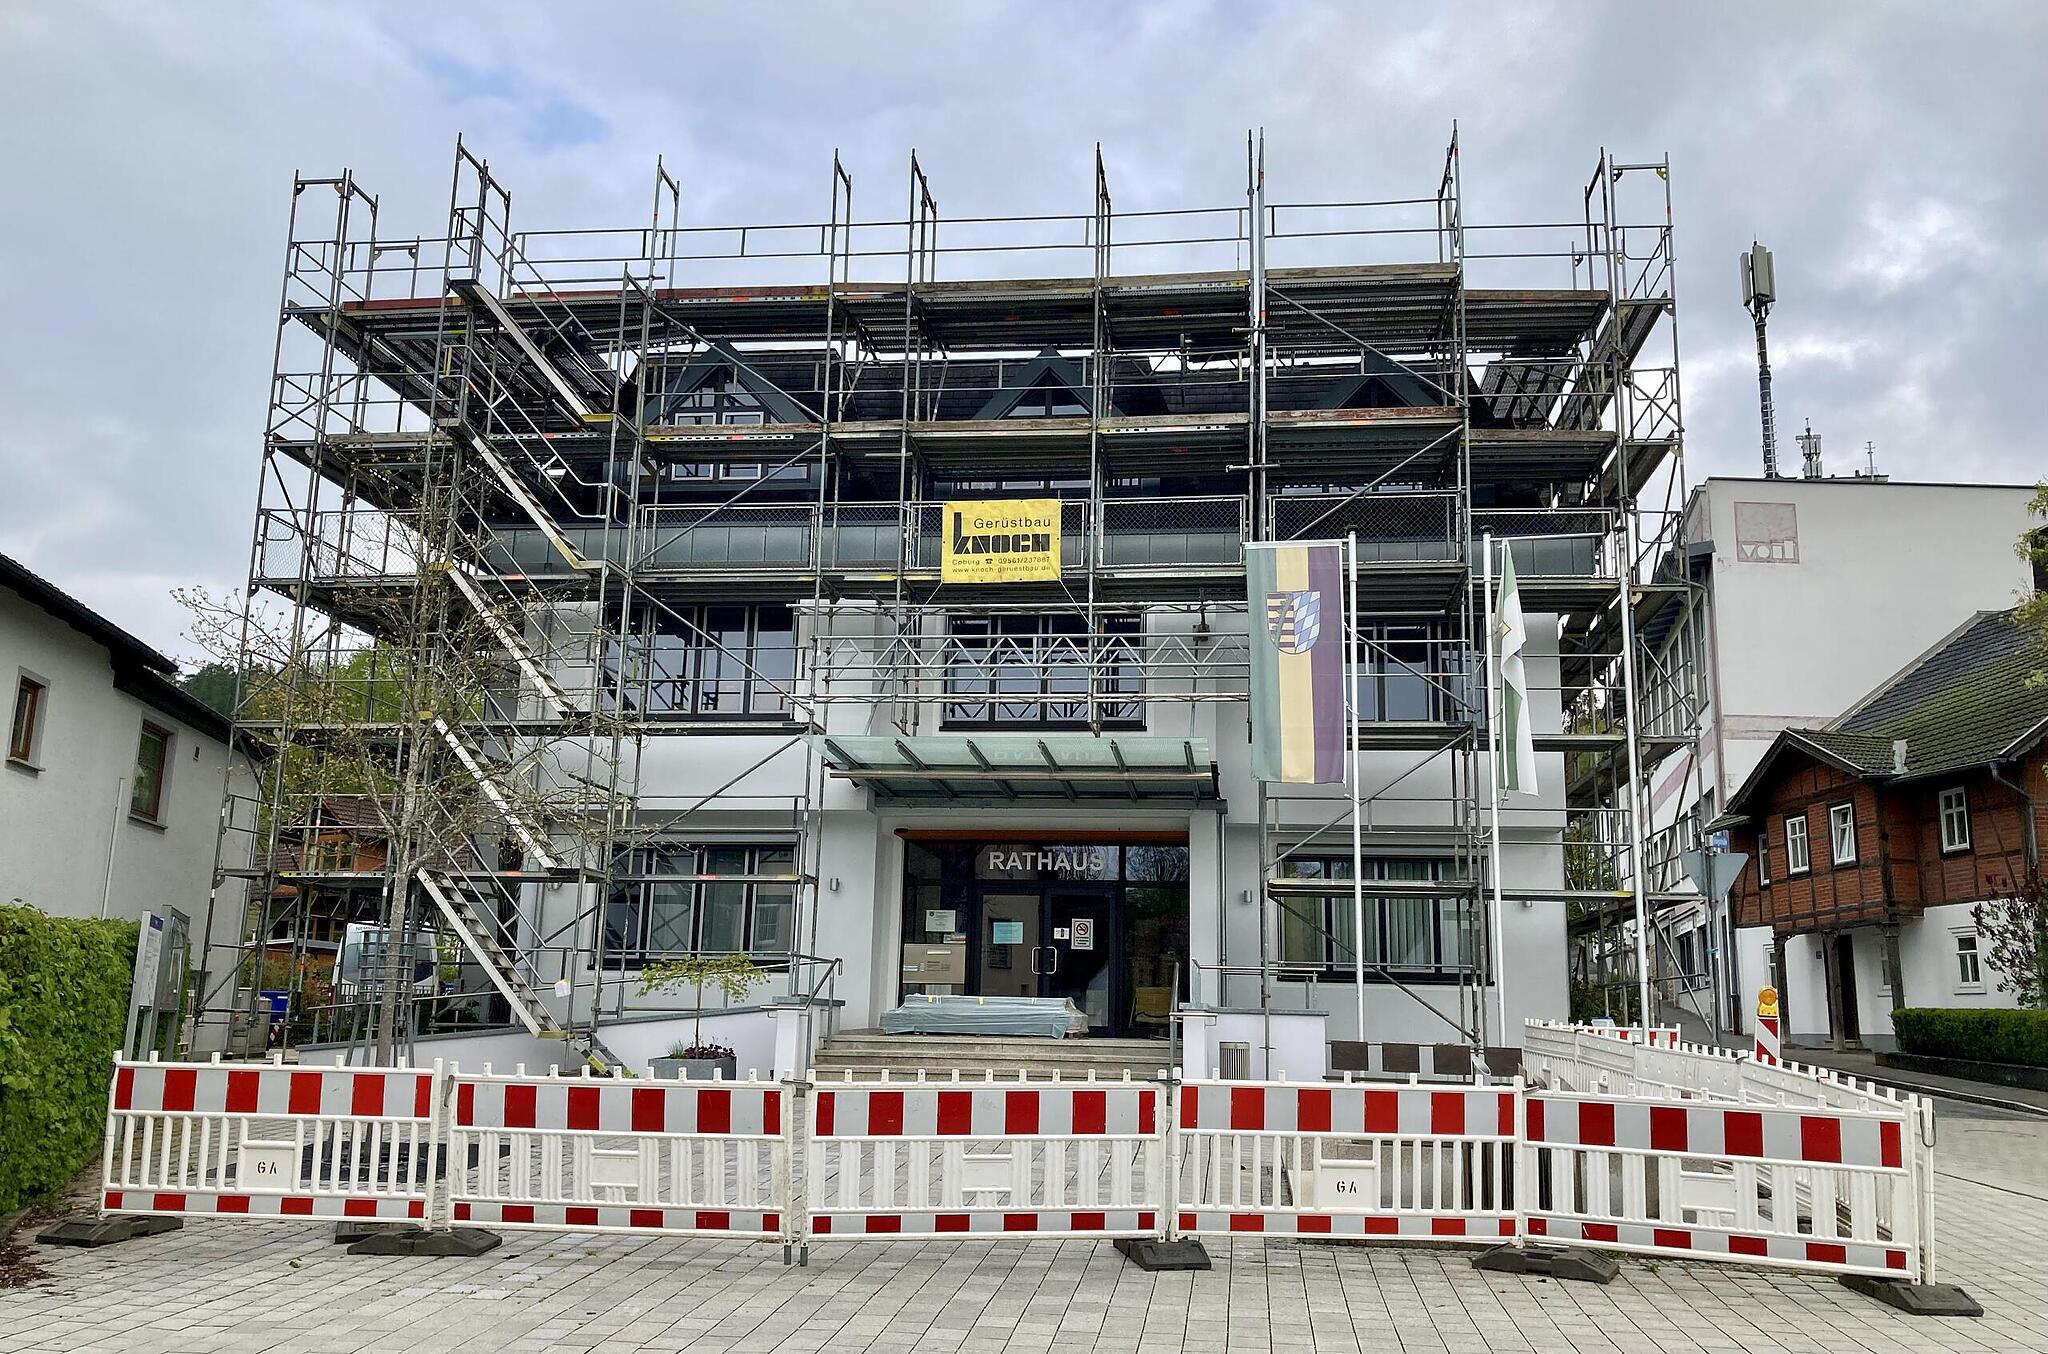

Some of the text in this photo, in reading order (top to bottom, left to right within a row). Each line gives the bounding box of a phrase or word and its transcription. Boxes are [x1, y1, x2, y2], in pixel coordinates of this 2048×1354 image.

[974, 517, 1051, 529] Gerüstbau
[953, 512, 1050, 554] KNOCH
[952, 558, 980, 567] Coburg
[989, 851, 1105, 871] RATHAUS
